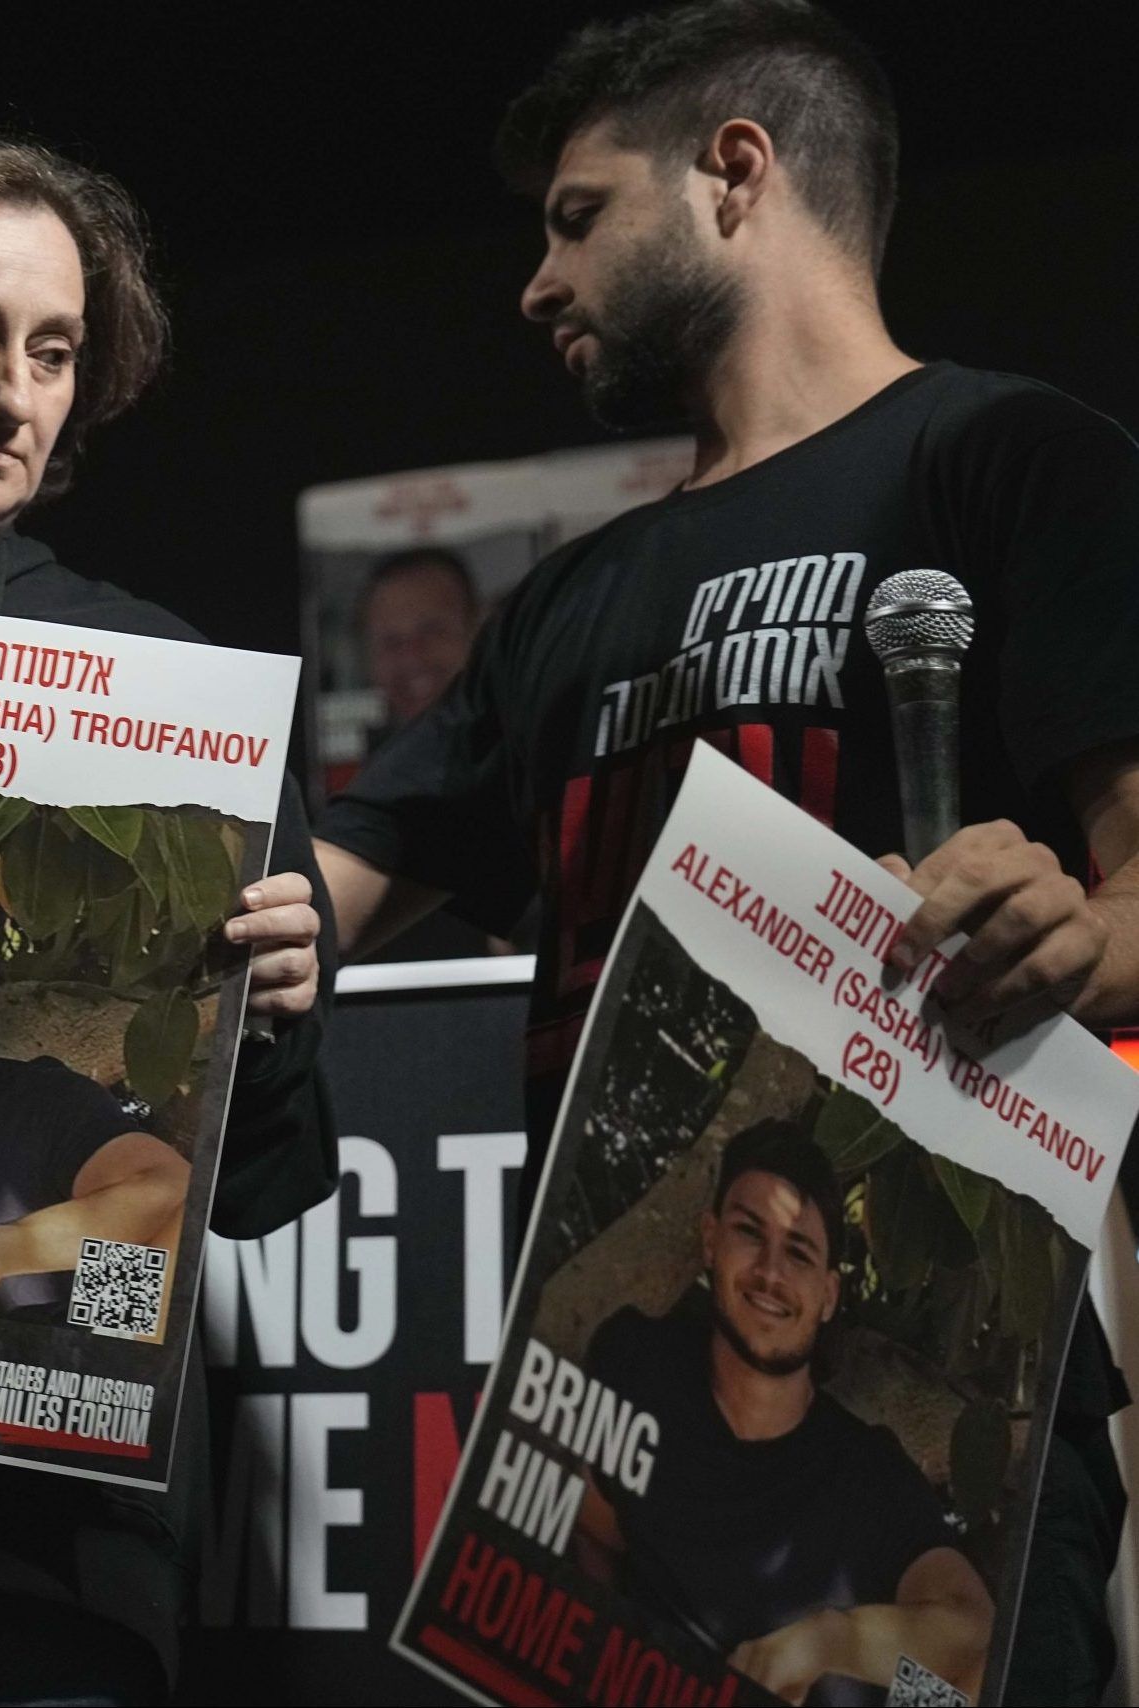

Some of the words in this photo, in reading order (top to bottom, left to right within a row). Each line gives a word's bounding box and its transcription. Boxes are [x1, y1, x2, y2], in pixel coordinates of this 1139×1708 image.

[681, 552, 867, 650] מחזירים
[715, 627, 851, 710] אותם
[70, 709, 268, 768] TROUFANOV
[670, 843, 836, 984] ALEXANDER
[834, 966, 942, 1073] (SASHA)
[948, 1052, 1105, 1183] TROUFANOV
[841, 1031, 901, 1106] (28)
[45, 1369, 81, 1398] AND
[80, 1375, 155, 1411] MISSING
[65, 1399, 151, 1447] FORUM
[509, 1338, 660, 1497] BRING
[478, 1432, 586, 1555] HIM
[440, 1533, 596, 1687] HOME
